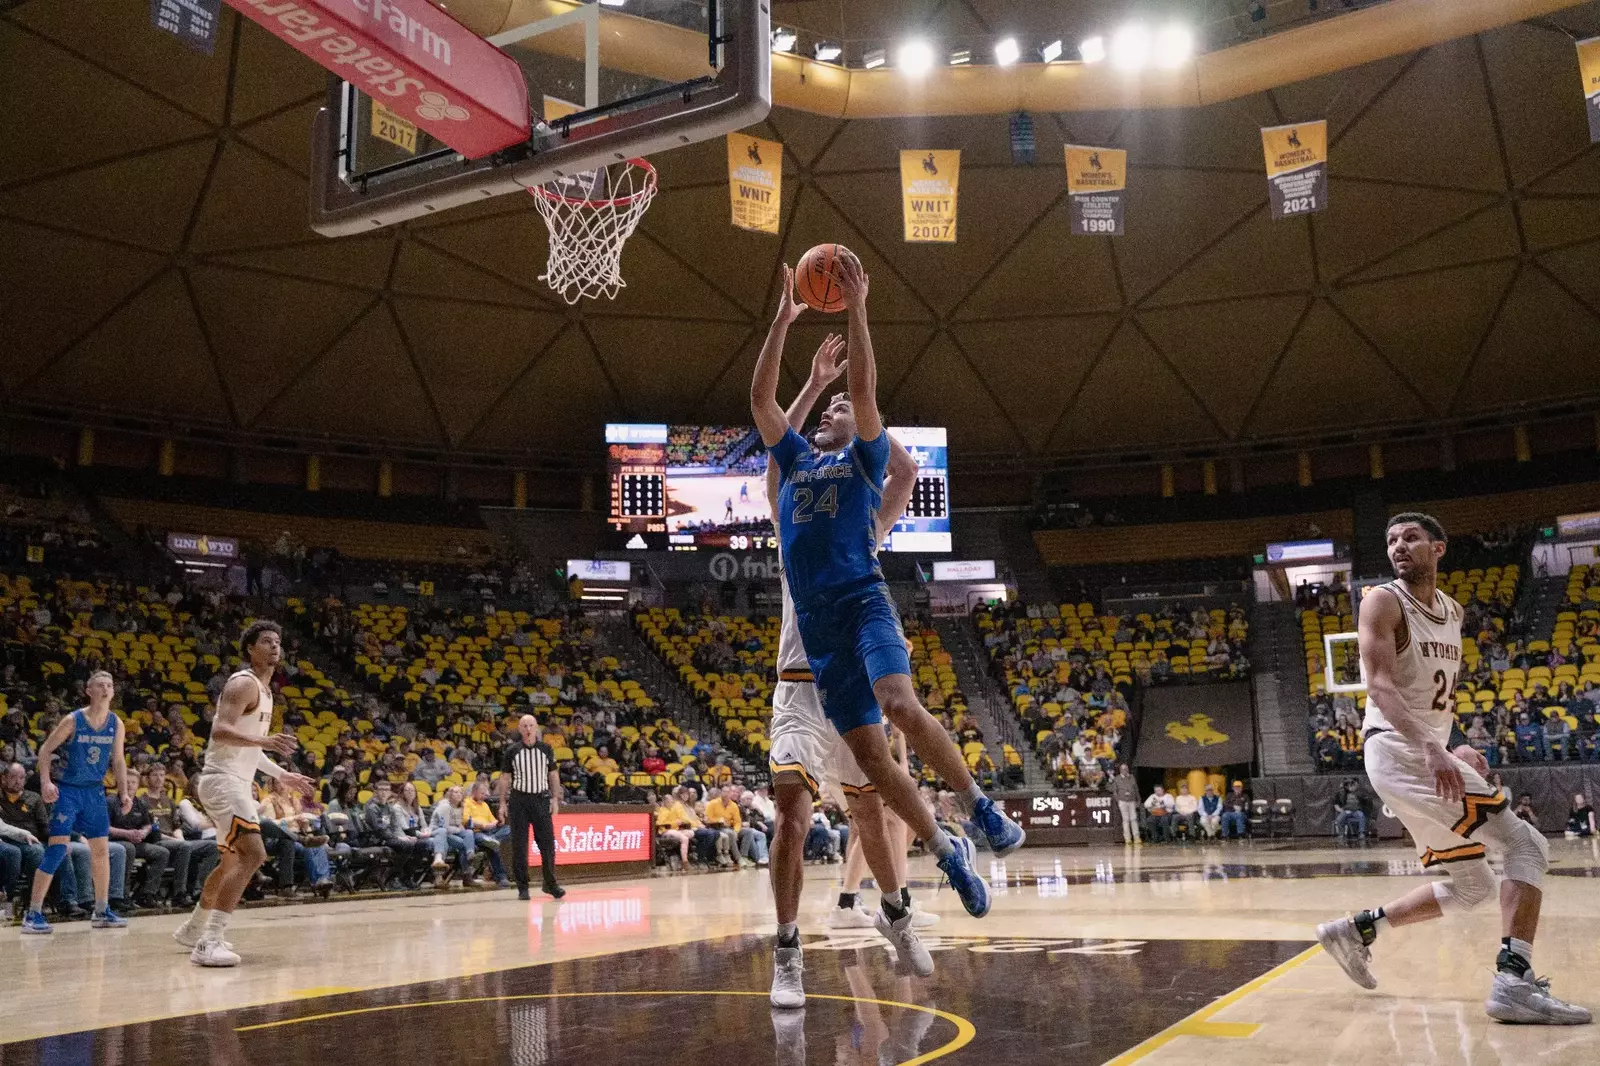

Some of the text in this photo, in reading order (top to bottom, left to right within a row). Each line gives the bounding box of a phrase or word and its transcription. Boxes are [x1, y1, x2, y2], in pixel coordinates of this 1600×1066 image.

[379, 120, 413, 147] 2017
[739, 184, 772, 204] WNIT
[910, 200, 950, 213] WNIT
[1283, 196, 1316, 214] 2021
[912, 226, 950, 238] 2007
[1081, 219, 1116, 233] 1990
[808, 464, 853, 482] FORCE
[793, 484, 839, 524] 24
[208, 541, 233, 552] WYO
[729, 536, 748, 549] 39
[1419, 641, 1460, 660] WYOMIN
[87, 746, 101, 765] 3
[1032, 797, 1064, 811] 15:46
[1085, 797, 1111, 807] GUEST
[1052, 814, 1060, 826] 2
[1092, 809, 1110, 823] 47
[559, 824, 641, 853] StateFarm
